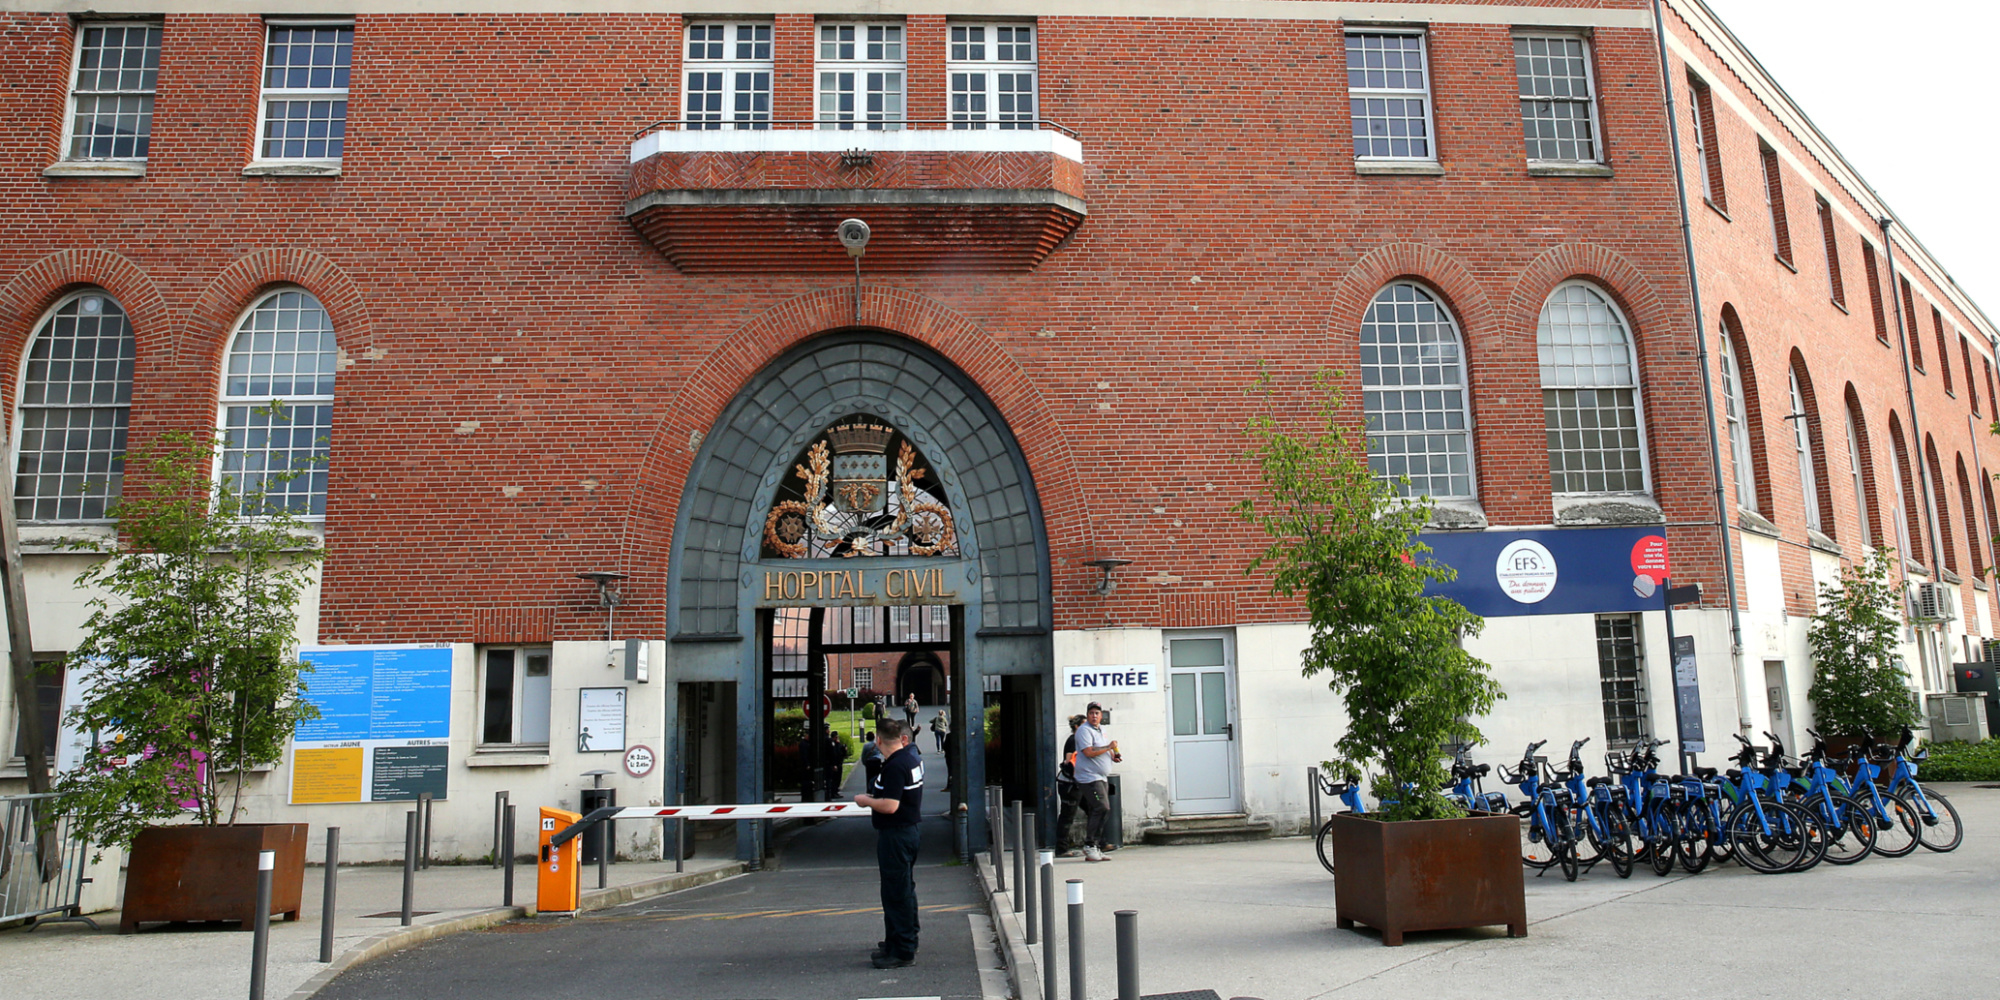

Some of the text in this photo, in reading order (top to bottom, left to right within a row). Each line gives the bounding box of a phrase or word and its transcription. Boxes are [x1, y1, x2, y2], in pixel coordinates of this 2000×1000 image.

[1515, 557, 1538, 570] EFS
[764, 569, 956, 600] HOPITAL CIVIL
[1508, 580, 1520, 588] Du
[1070, 668, 1149, 688] ENTRÉE
[544, 820, 554, 829] 11
